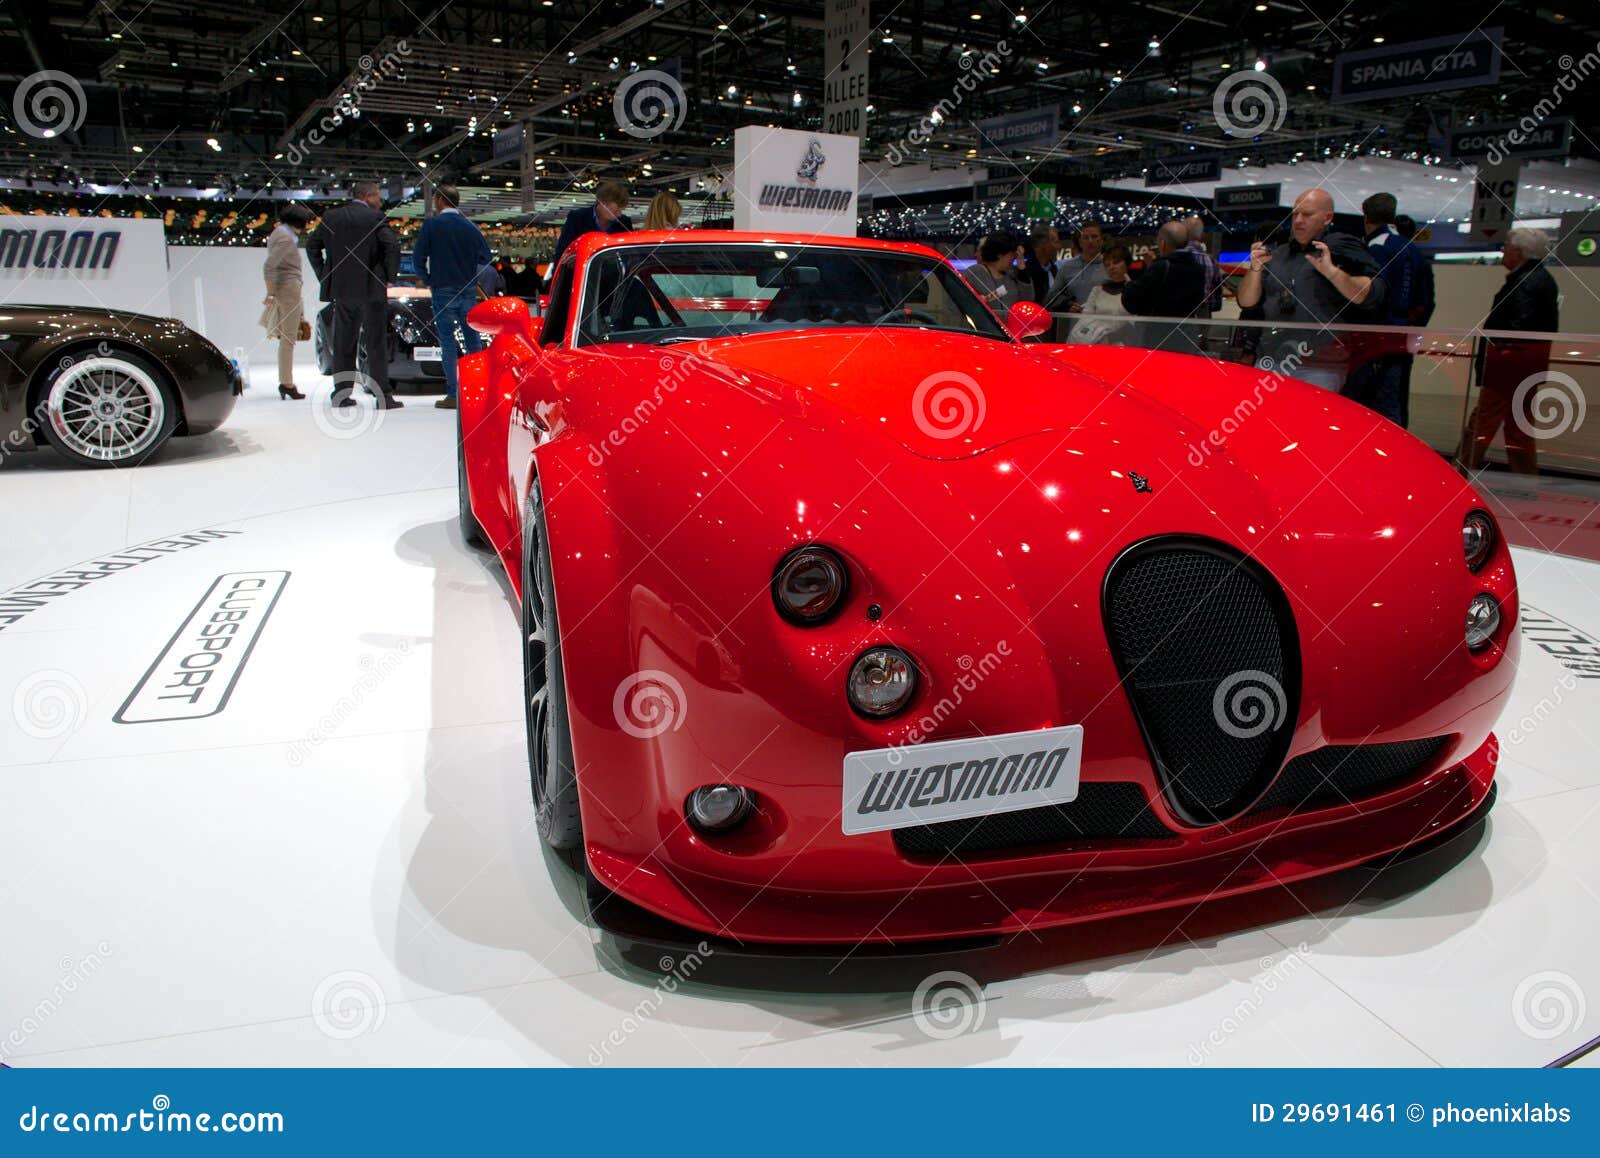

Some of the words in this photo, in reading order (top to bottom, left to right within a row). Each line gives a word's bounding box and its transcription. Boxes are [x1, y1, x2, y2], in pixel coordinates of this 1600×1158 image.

[1351, 57, 1426, 85] SPANIA
[1431, 49, 1477, 73] GTA
[825, 74, 865, 105] ALLEE
[828, 107, 860, 135] 2000
[1007, 119, 1048, 138] DESIGN
[1457, 129, 1555, 150] GOODEAR
[1478, 180, 1515, 199] WC
[157, 577, 266, 704] CLUBSPORT
